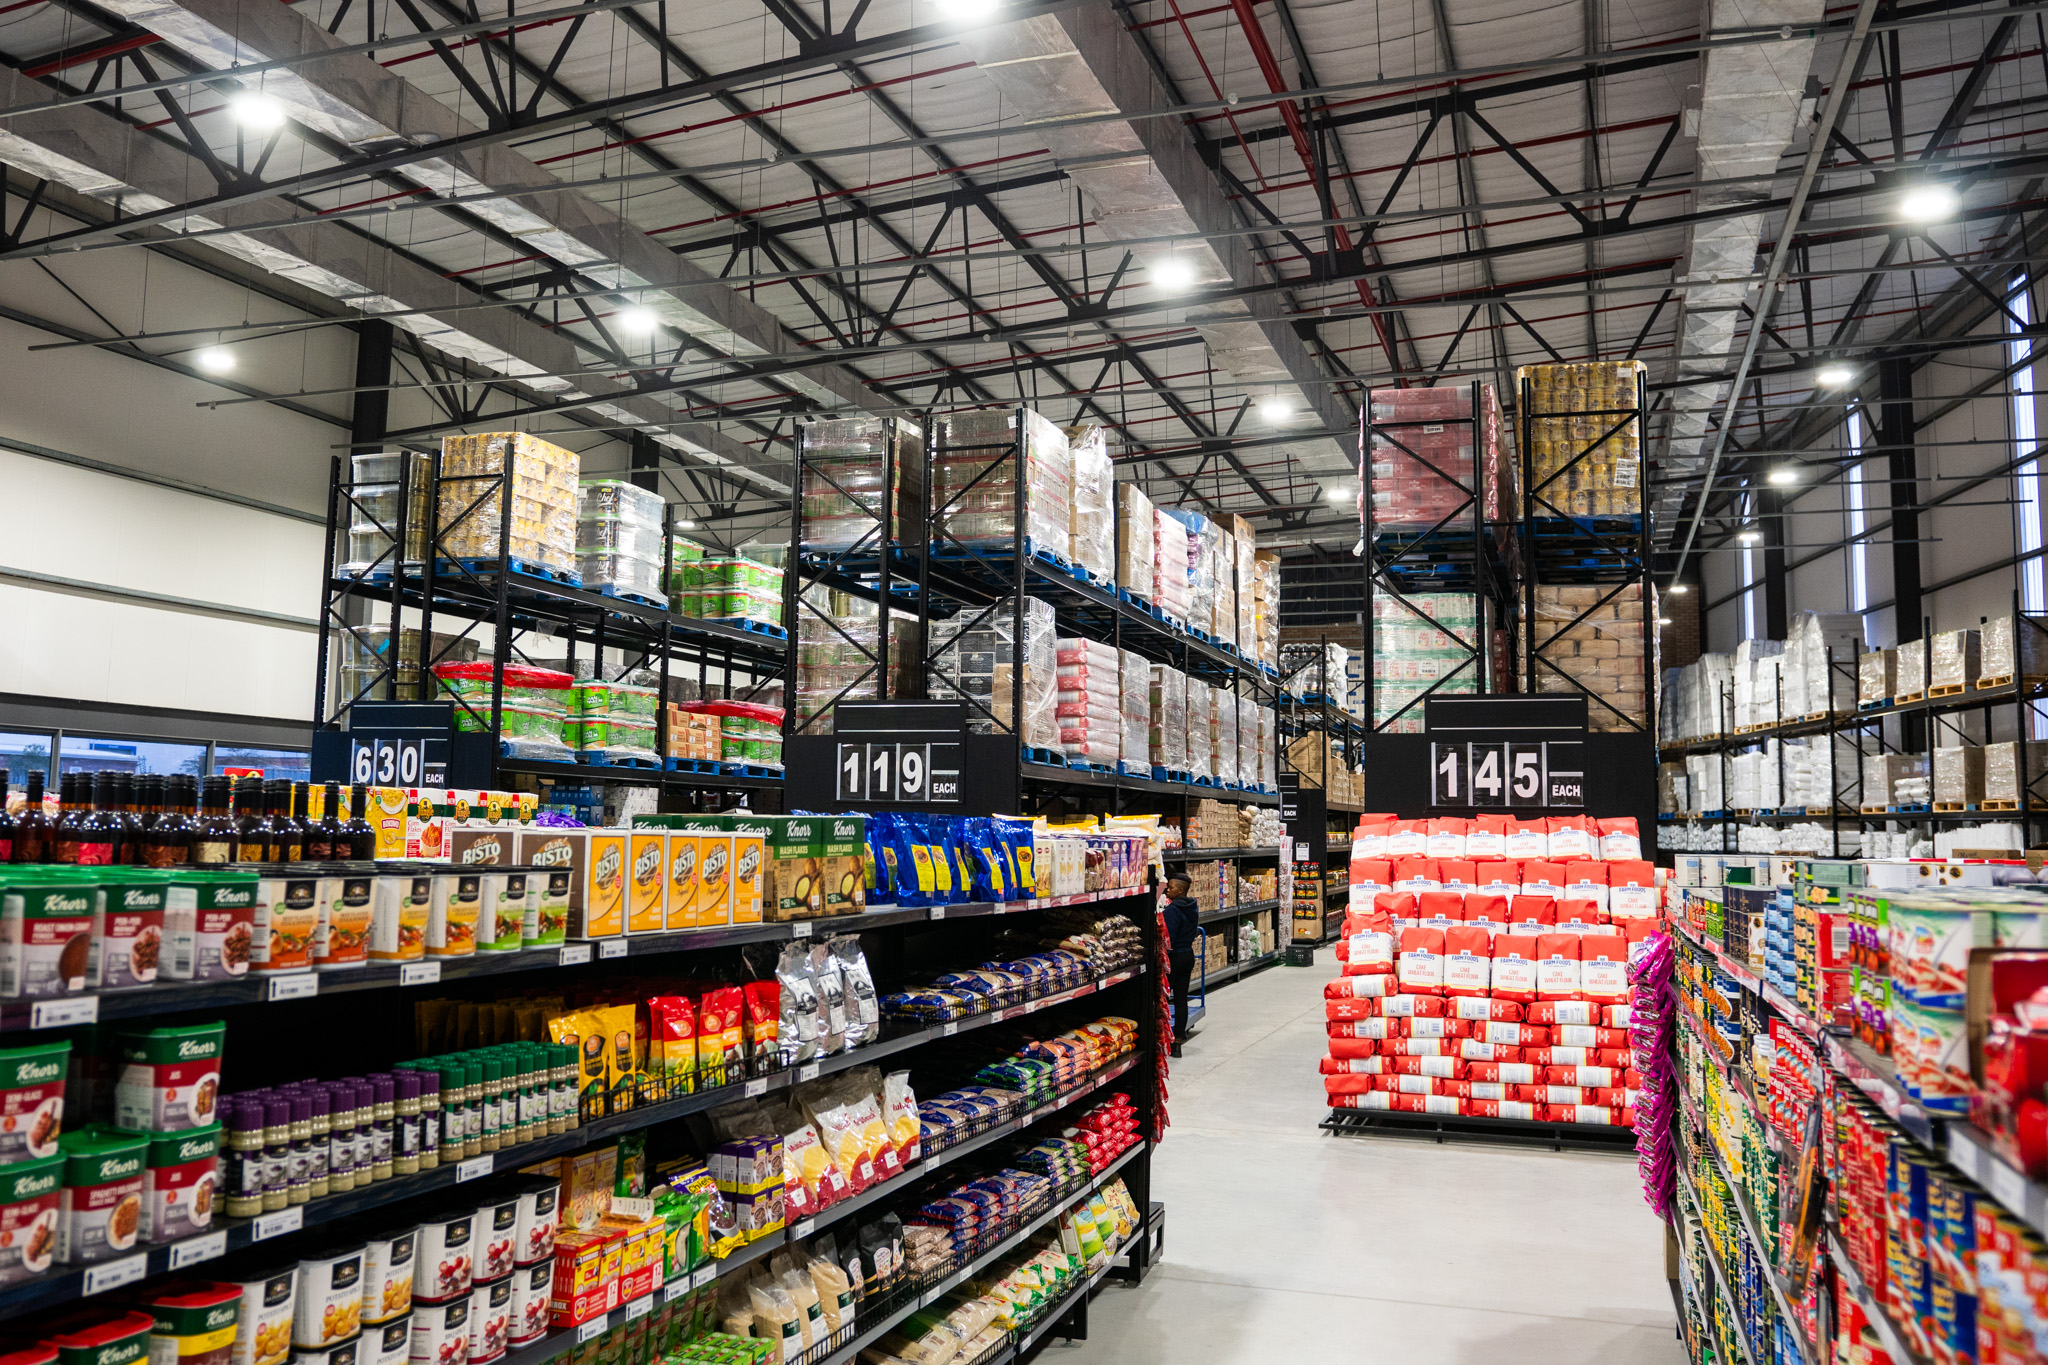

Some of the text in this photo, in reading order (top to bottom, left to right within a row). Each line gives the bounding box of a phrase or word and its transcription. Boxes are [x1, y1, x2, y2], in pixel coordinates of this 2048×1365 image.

[355, 746, 444, 783] 630 EACH
[844, 751, 956, 794] 119 EACH
[1439, 751, 1581, 798] 145 EACH
[786, 820, 812, 838] Knorr
[833, 820, 856, 836] Knorr
[462, 843, 501, 864] BISTO
[531, 846, 572, 866] BISTO
[779, 845, 808, 854] MASH FLAKES
[827, 844, 853, 853] MASH FLAKES
[595, 852, 620, 884] BISTO
[634, 849, 661, 880] BISTO
[672, 850, 696, 880] BISTO
[702, 850, 727, 879] BISTO
[737, 850, 760, 878] BISTO
[43, 894, 88, 911] Knorr
[124, 890, 160, 905] Knorr
[214, 888, 250, 903] Knorr
[178, 1040, 216, 1057] Knorr
[16, 1062, 60, 1081] Knorr
[179, 1140, 215, 1158] Knorr
[99, 1159, 139, 1177] Knorr
[14, 1175, 55, 1195] Knorr
[654, 1264, 662, 1276] 12
[609, 1283, 616, 1295] 12
[207, 1307, 235, 1327] Knorr
[98, 1343, 140, 1365] Knorr
